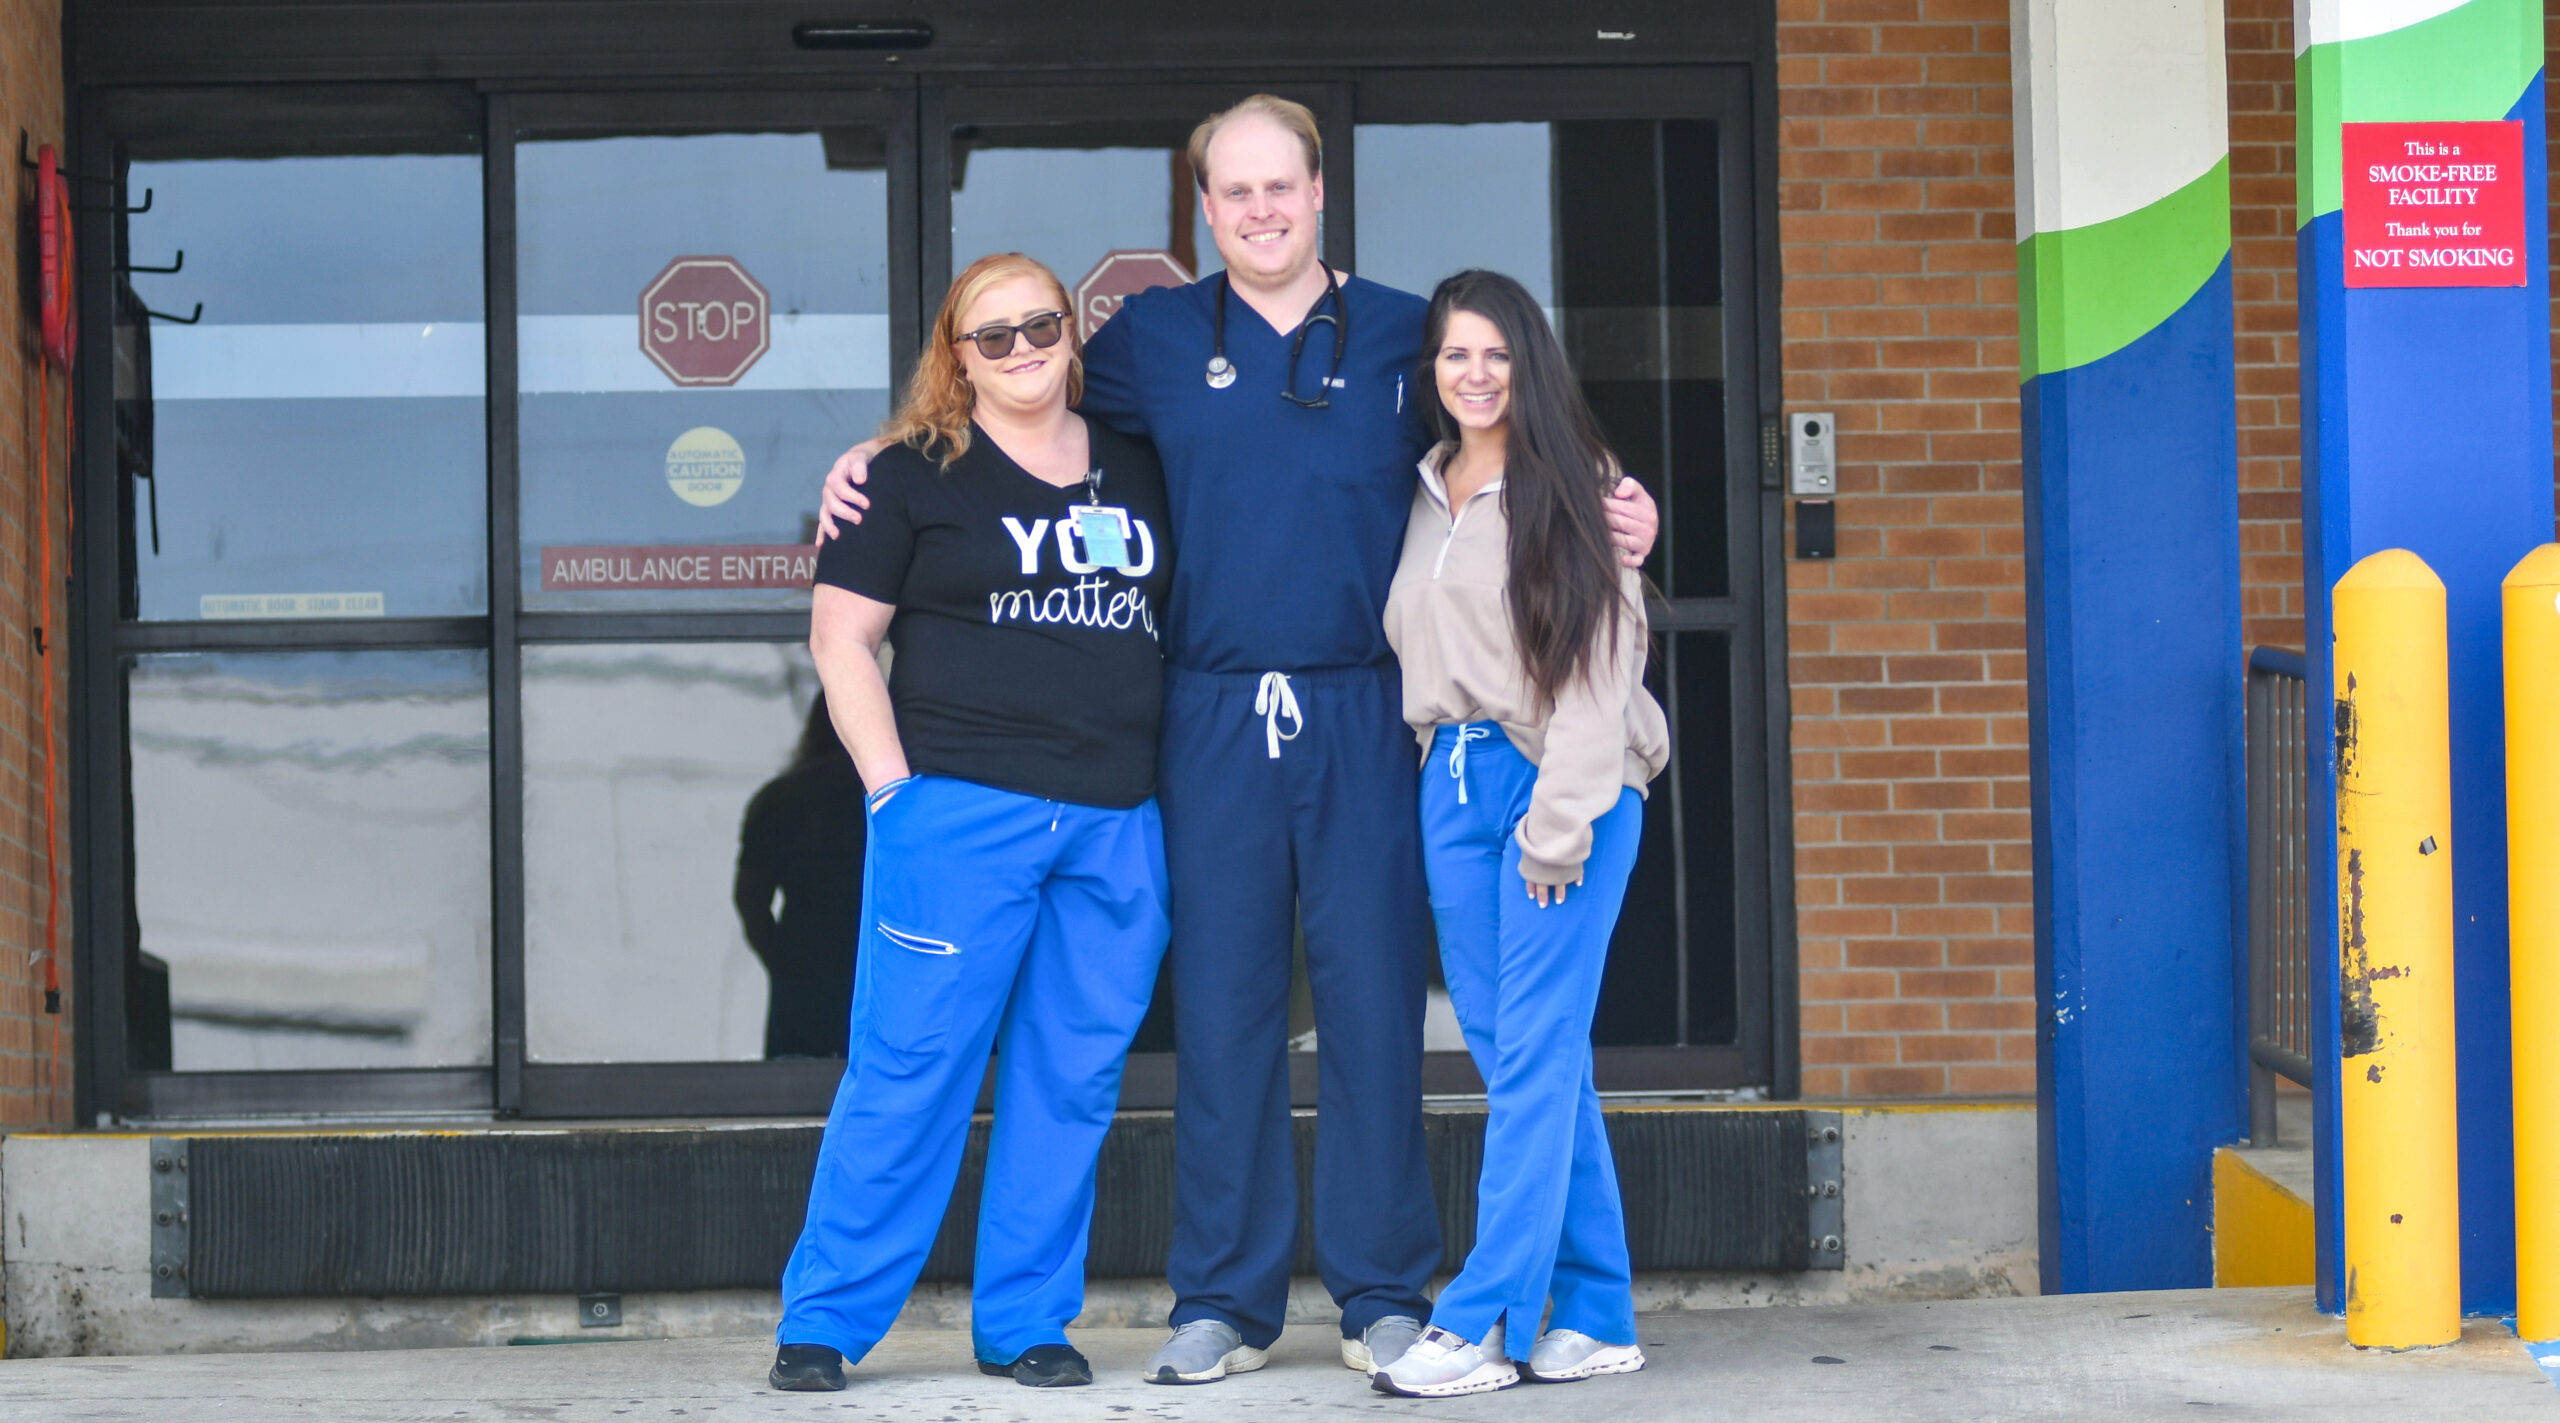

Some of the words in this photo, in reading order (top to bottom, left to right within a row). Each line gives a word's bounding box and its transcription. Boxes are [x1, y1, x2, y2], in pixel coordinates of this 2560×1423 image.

[2404, 142, 2435, 156] This
[2439, 143, 2449, 156] is
[2452, 146, 2461, 156] a
[2369, 165, 2497, 182] SMOKE-FREE
[2389, 188, 2479, 205] FACILITY
[2385, 222, 2431, 237] Thank
[2434, 226, 2458, 239] you
[2462, 222, 2482, 236] for
[2354, 249, 2404, 268] NOT
[2408, 248, 2514, 267] SMOKING
[654, 301, 756, 343] STOP
[668, 463, 742, 477] CAUTION
[552, 556, 710, 583] AMBULANCE
